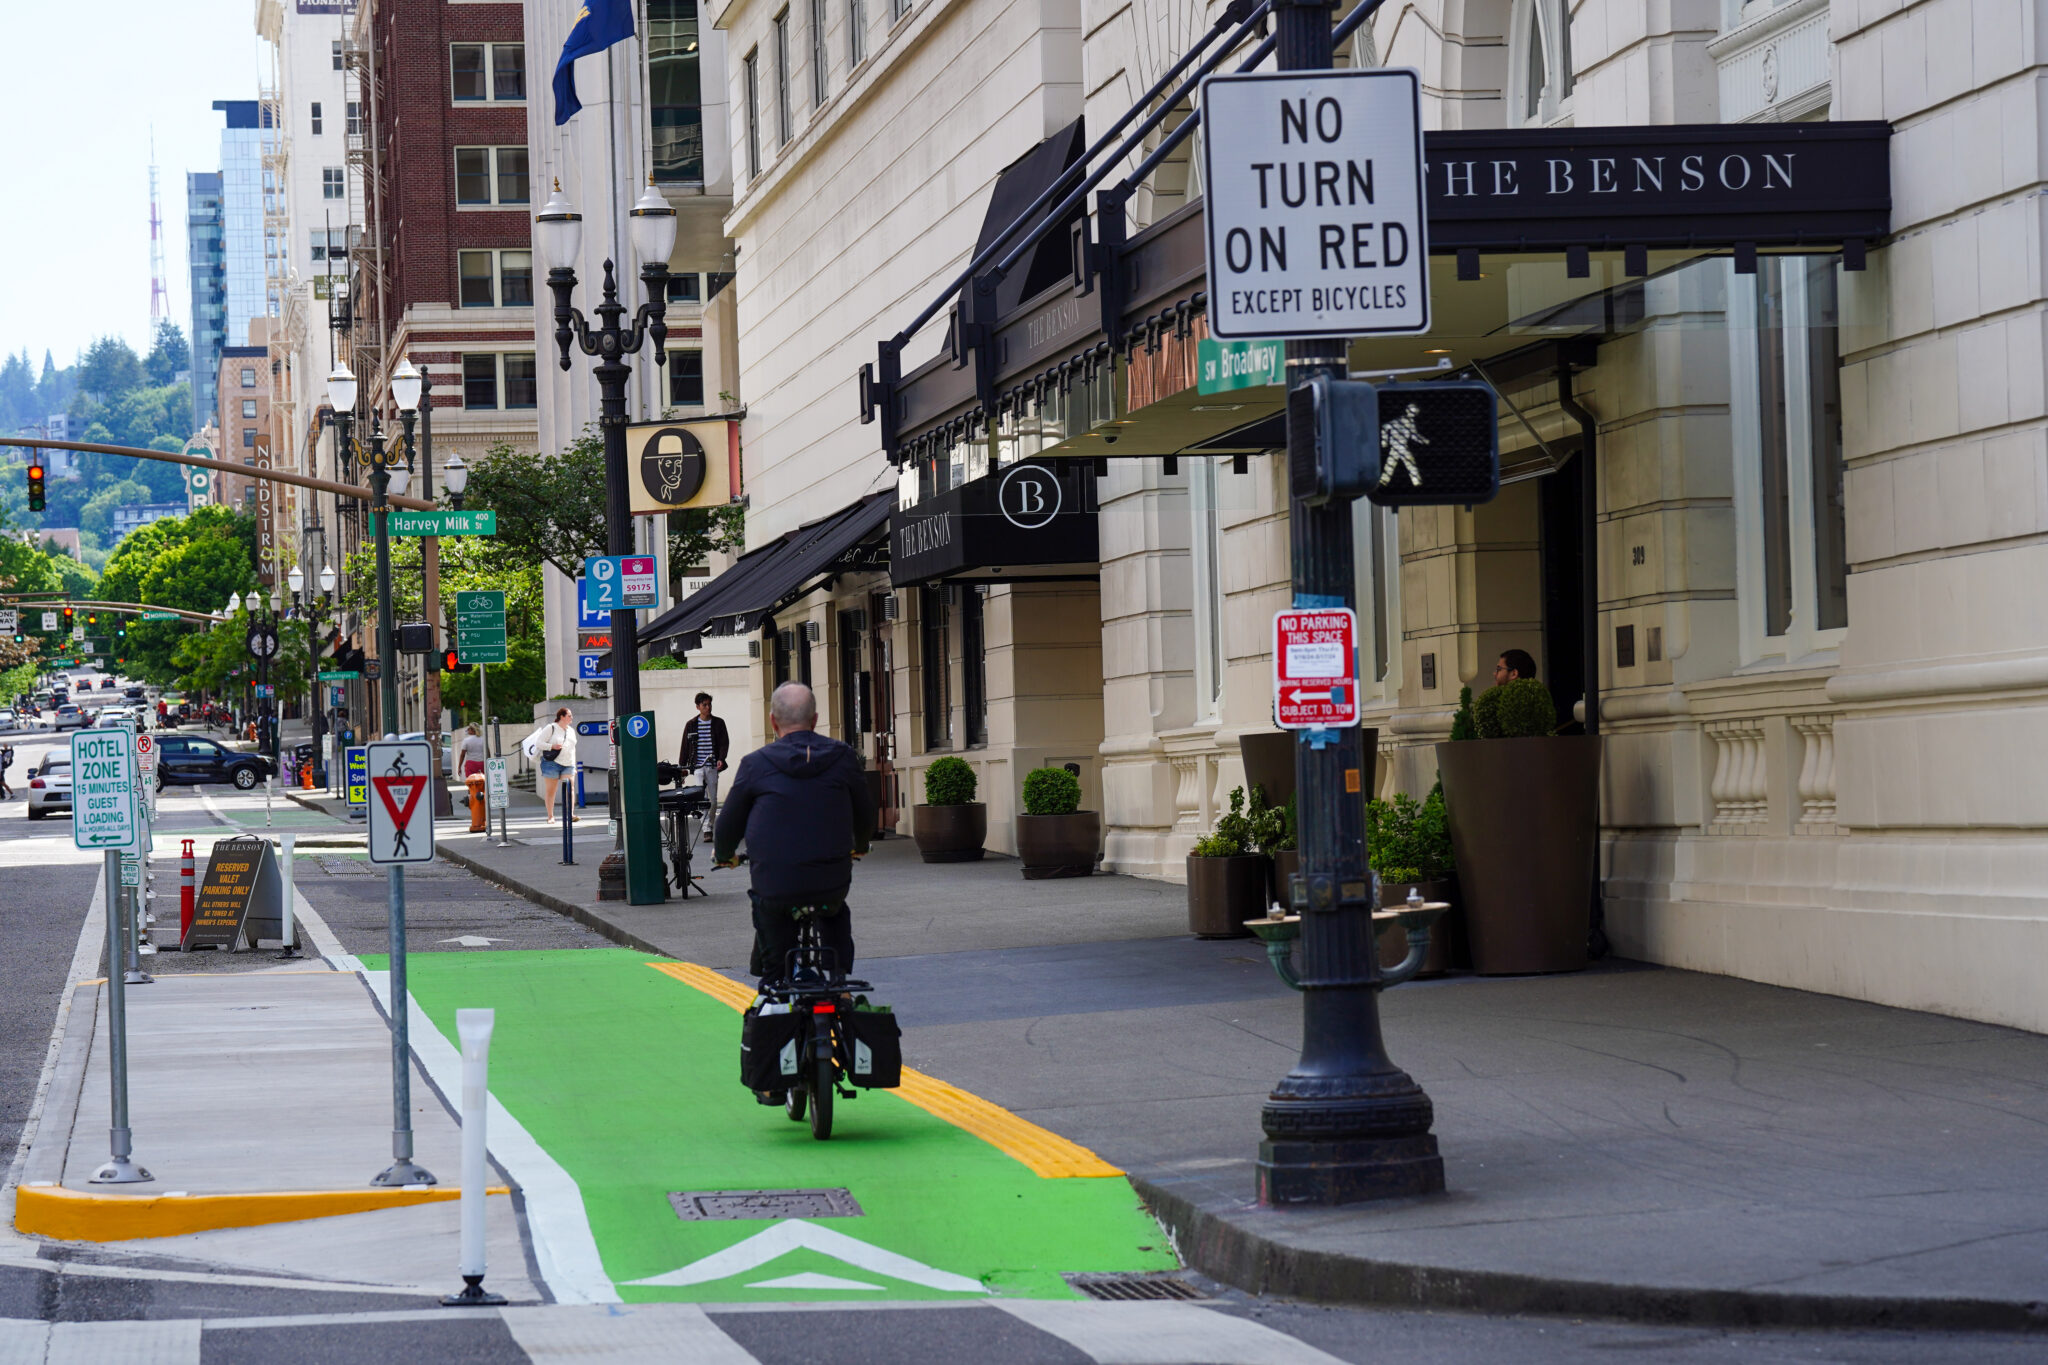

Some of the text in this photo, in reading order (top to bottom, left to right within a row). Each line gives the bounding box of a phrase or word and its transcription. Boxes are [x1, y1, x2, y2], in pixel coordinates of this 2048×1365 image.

[1281, 97, 1342, 144] NO
[1424, 153, 1796, 196] HE BENSON
[1251, 159, 1374, 208] TURN
[1225, 222, 1408, 273] ON RED
[1232, 285, 1407, 314] EXCEPT BICYCLES
[1028, 298, 1080, 349] THE BENSON
[1205, 344, 1277, 381] SW Broadway
[1017, 480, 1044, 513] B
[257, 444, 273, 575] NORDSTROM
[475, 513, 489, 521] 400
[394, 516, 470, 533] Harvey Milk
[475, 521, 482, 530] St
[900, 524, 916, 559] THE
[917, 511, 951, 553] BENSON
[1632, 545, 1645, 566] 309
[598, 583, 613, 602] 2
[626, 583, 651, 592] 59175
[1280, 615, 1348, 631] NO PARKING
[1286, 630, 1344, 644] THIS SPACE
[1302, 678, 1332, 686] RESERVED
[1332, 677, 1353, 685] HOURS
[1281, 703, 1354, 716] SUBJECT TO TOW
[78, 740, 124, 759] HOTEL
[82, 761, 120, 780] ZONE
[77, 781, 128, 795] 15 MINUTES
[392, 788, 409, 796] YIELD
[87, 797, 118, 809] GUEST
[83, 812, 124, 825] LOADING
[231, 843, 262, 851] BENSON
[216, 863, 250, 872] RESERVED
[219, 874, 241, 884] VALET
[202, 885, 251, 895] PARKING ONLY
